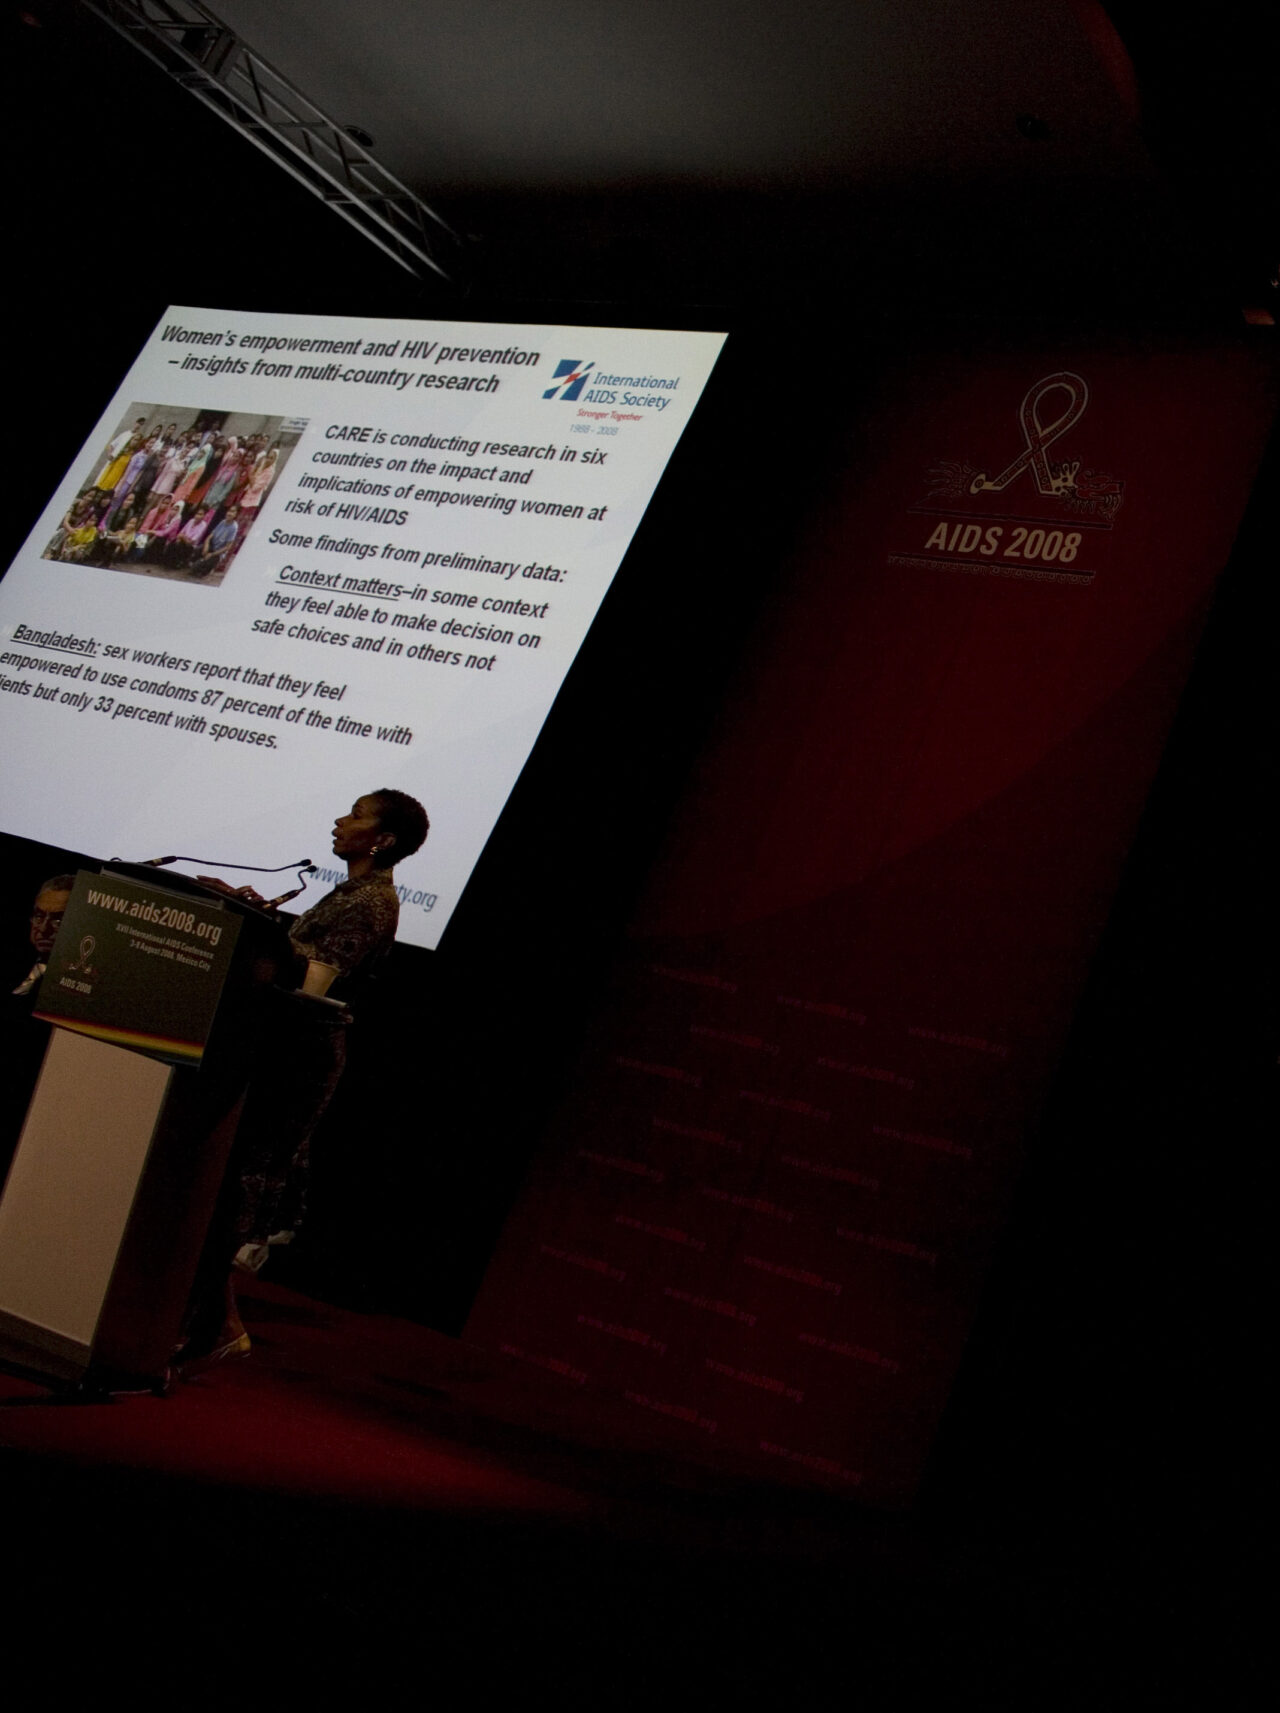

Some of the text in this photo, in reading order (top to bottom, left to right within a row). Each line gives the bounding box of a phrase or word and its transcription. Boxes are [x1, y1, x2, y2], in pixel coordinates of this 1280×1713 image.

[160, 325, 541, 366] Women's empowerment and HIV prevention
[180, 353, 250, 377] insights
[250, 358, 296, 378] from
[293, 362, 416, 391] multi-country
[415, 373, 501, 393] research
[593, 371, 681, 390] International
[582, 389, 673, 412] AIDS Society
[610, 410, 644, 422] Together
[311, 450, 534, 485] countries on the impact and
[325, 424, 373, 443] CARE
[372, 428, 388, 444] is
[390, 433, 481, 457] conducting
[482, 441, 557, 460] research
[559, 445, 578, 462] in
[580, 448, 608, 465] six
[284, 498, 409, 526] risk of HIV/AIDS
[297, 472, 608, 522] implications of empowering women at
[268, 528, 568, 583] Some findings from preliminary data:
[924, 521, 1083, 563] AIDS 2008
[278, 565, 342, 588] Context
[430, 590, 479, 608] some
[481, 597, 550, 619] context
[264, 590, 542, 649] they feel able to make decision on
[11, 624, 348, 701] Bangladesh: sex workers report that they feel
[250, 618, 497, 672] safe choices and in others not
[0, 651, 414, 746] empowered to use condoms 87 percent of the time with
[32, 681, 60, 701] but
[60, 690, 94, 712] only
[94, 695, 114, 713] 33
[111, 703, 174, 727] percent
[174, 713, 208, 735] with
[208, 722, 278, 750] spouses.
[86, 889, 223, 947] www.aids2008.org
